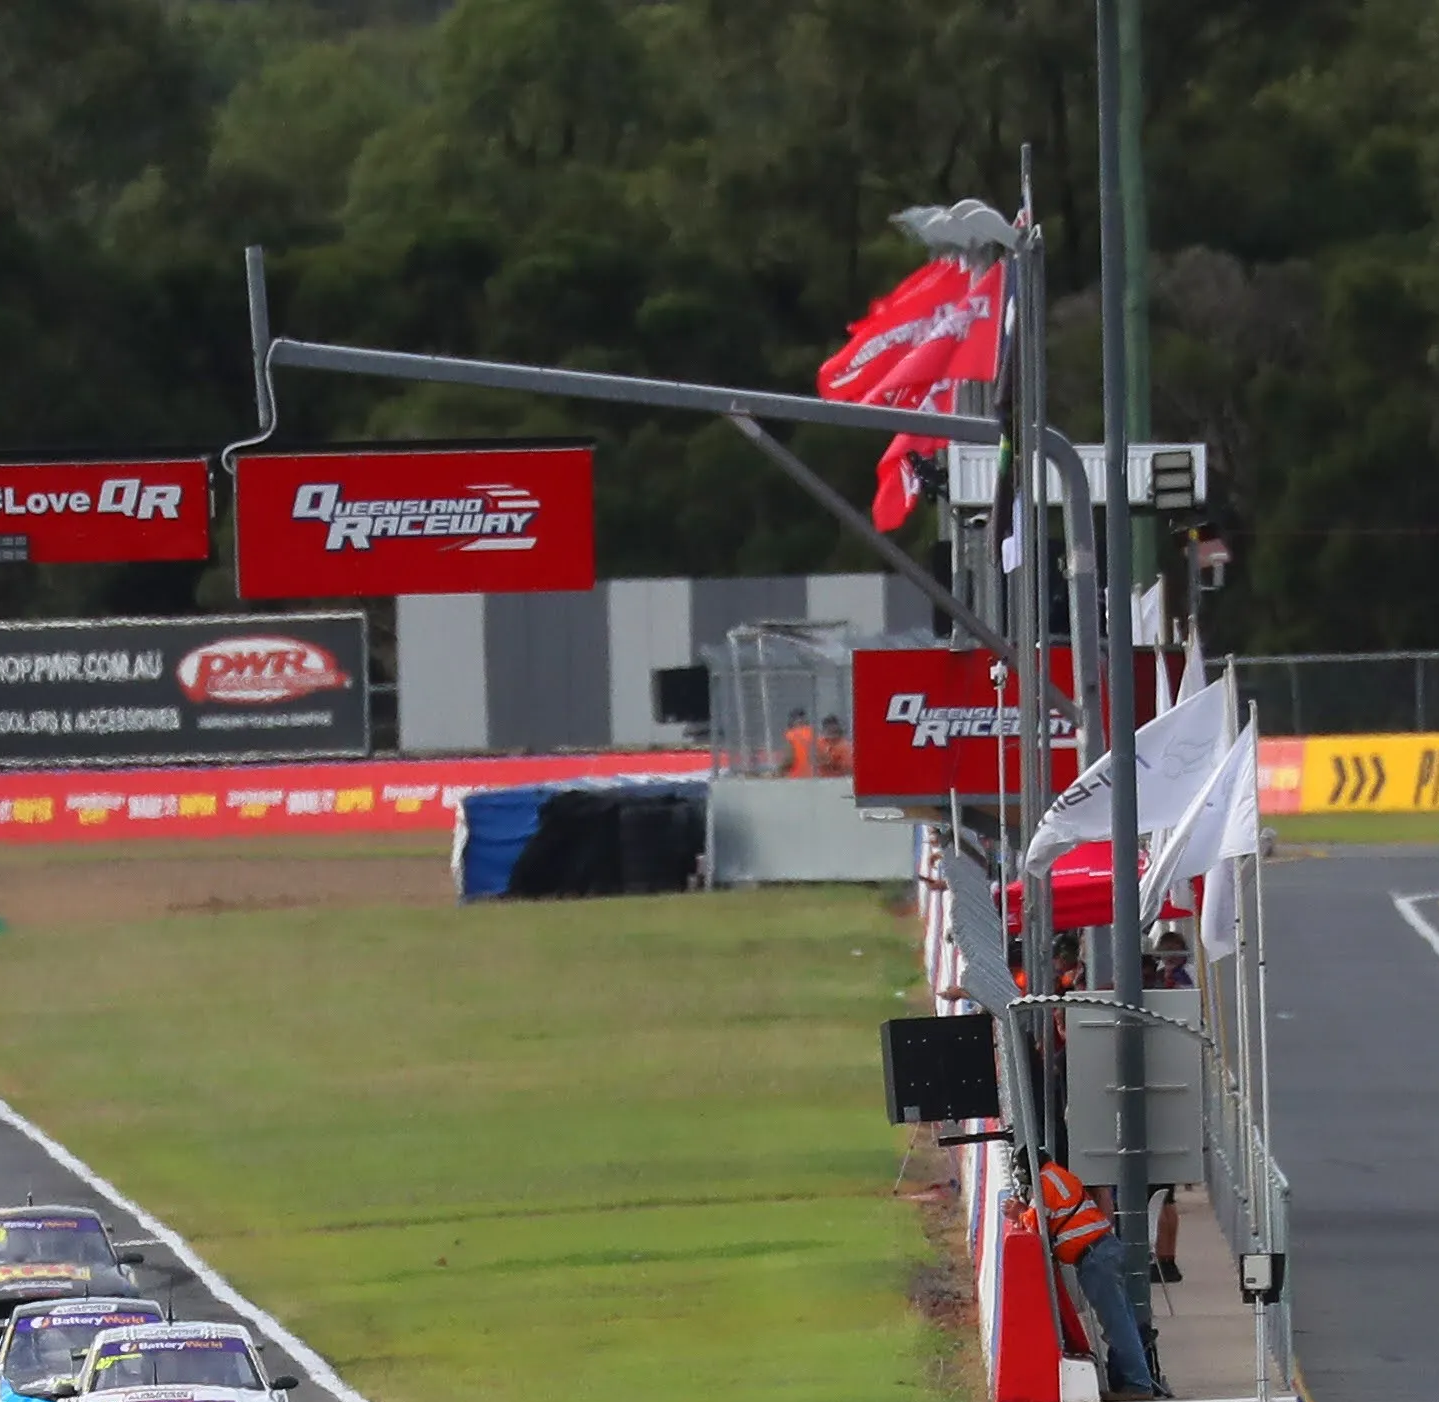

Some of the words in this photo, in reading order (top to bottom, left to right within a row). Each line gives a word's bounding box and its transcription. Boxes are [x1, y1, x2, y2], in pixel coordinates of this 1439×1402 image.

[97, 478, 182, 520] QR
[291, 483, 484, 522] QUEENSLAND
[325, 512, 532, 550] RACEWAY
[190, 649, 309, 702] PWR
